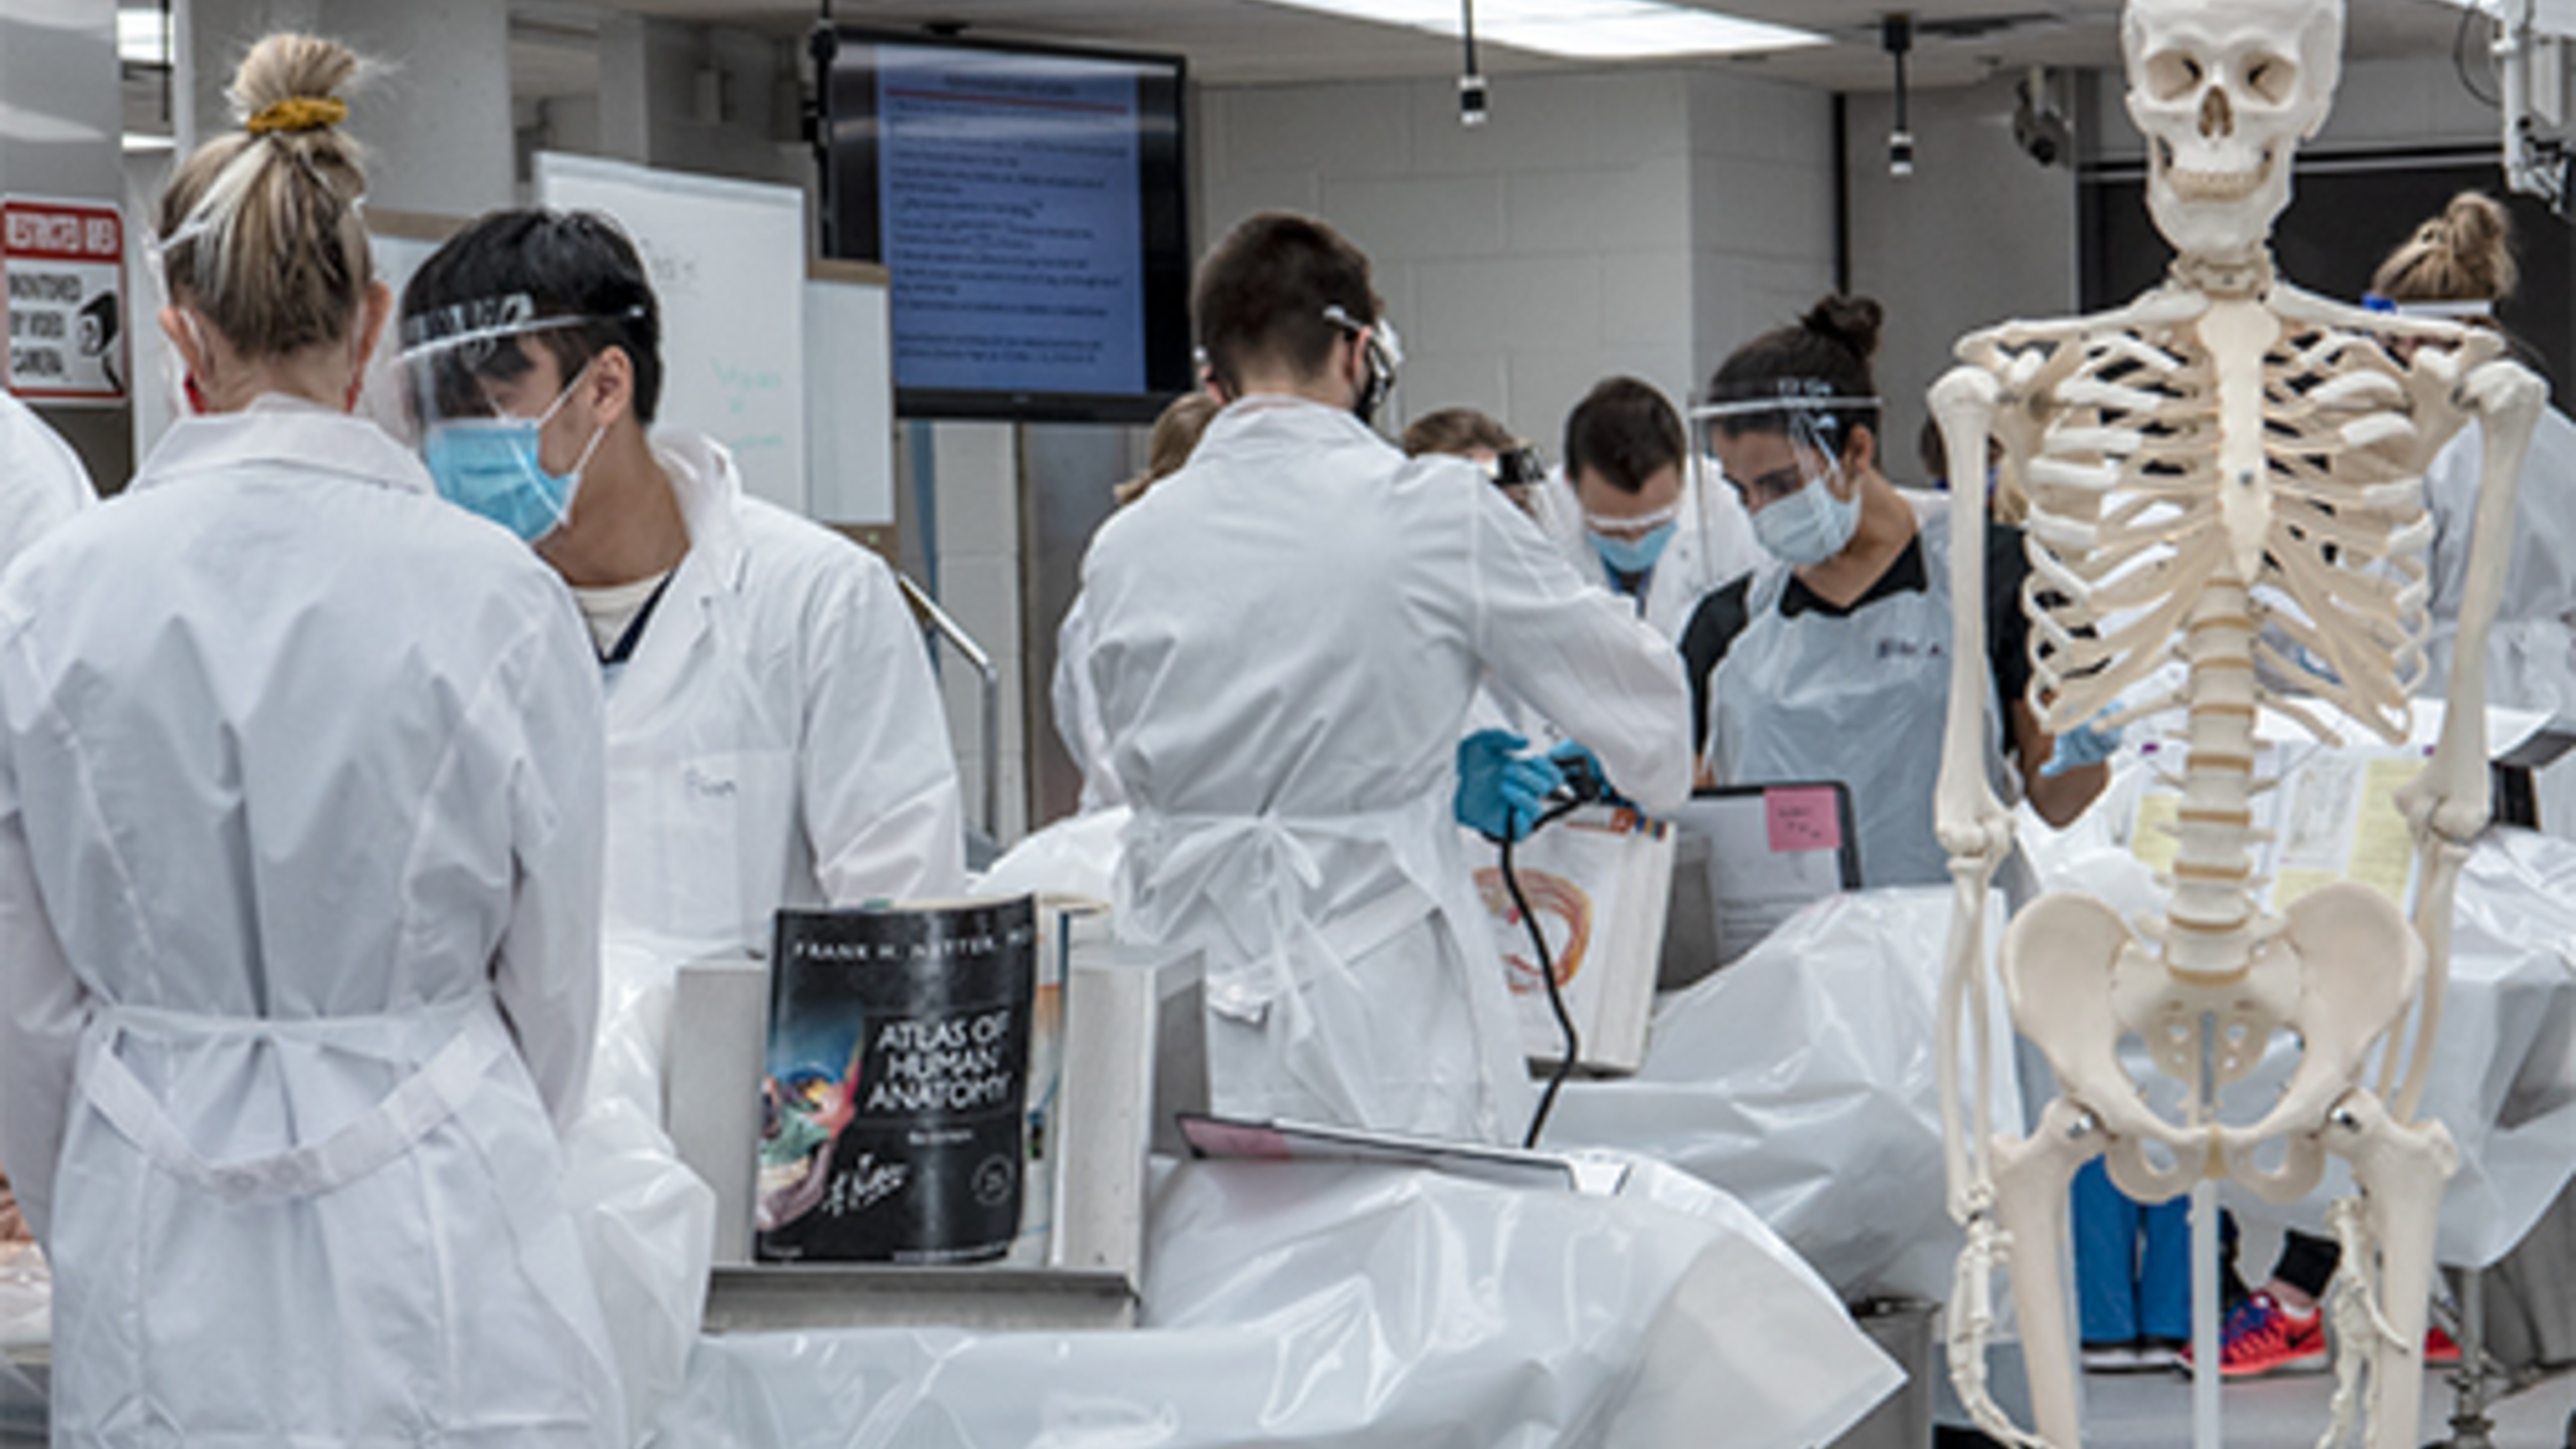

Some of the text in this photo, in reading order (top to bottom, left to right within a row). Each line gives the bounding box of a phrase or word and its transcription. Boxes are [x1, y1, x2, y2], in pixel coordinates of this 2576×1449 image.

[794, 942, 868, 961] FRANK
[877, 1009, 1010, 1050] ATLAS OF
[887, 1046, 1002, 1080] HUMAN
[867, 1071, 1012, 1110] ANATOMY
